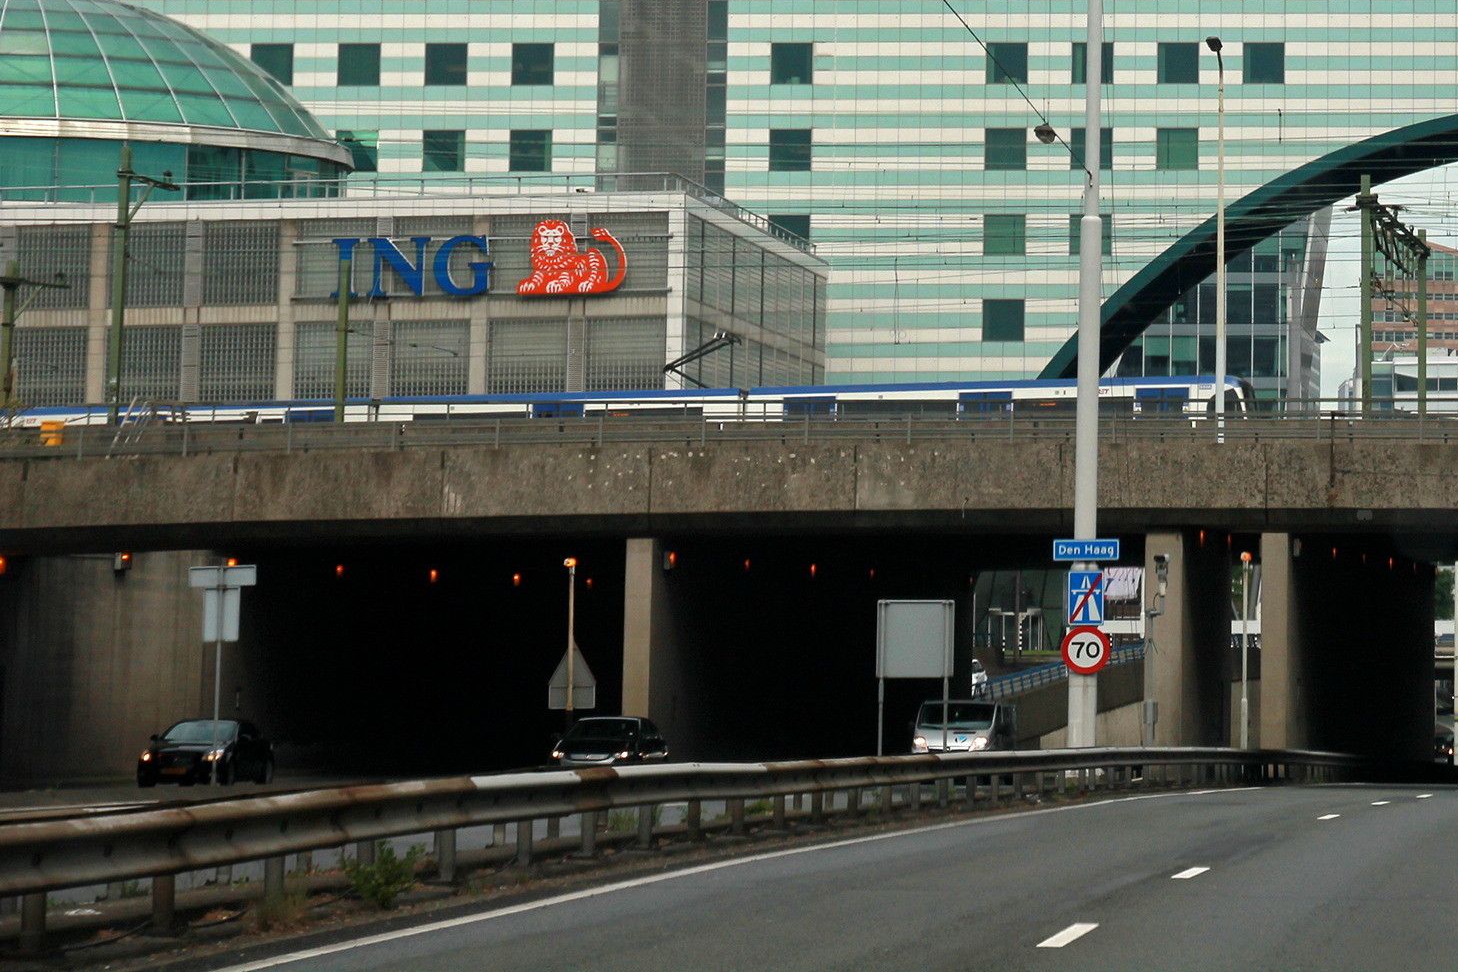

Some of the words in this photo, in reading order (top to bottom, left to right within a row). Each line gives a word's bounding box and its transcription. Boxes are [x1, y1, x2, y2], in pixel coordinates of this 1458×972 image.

[330, 235, 494, 298] ING
[1058, 544, 1081, 556] Den
[1084, 544, 1115, 558] Haag
[1071, 641, 1100, 659] 70
